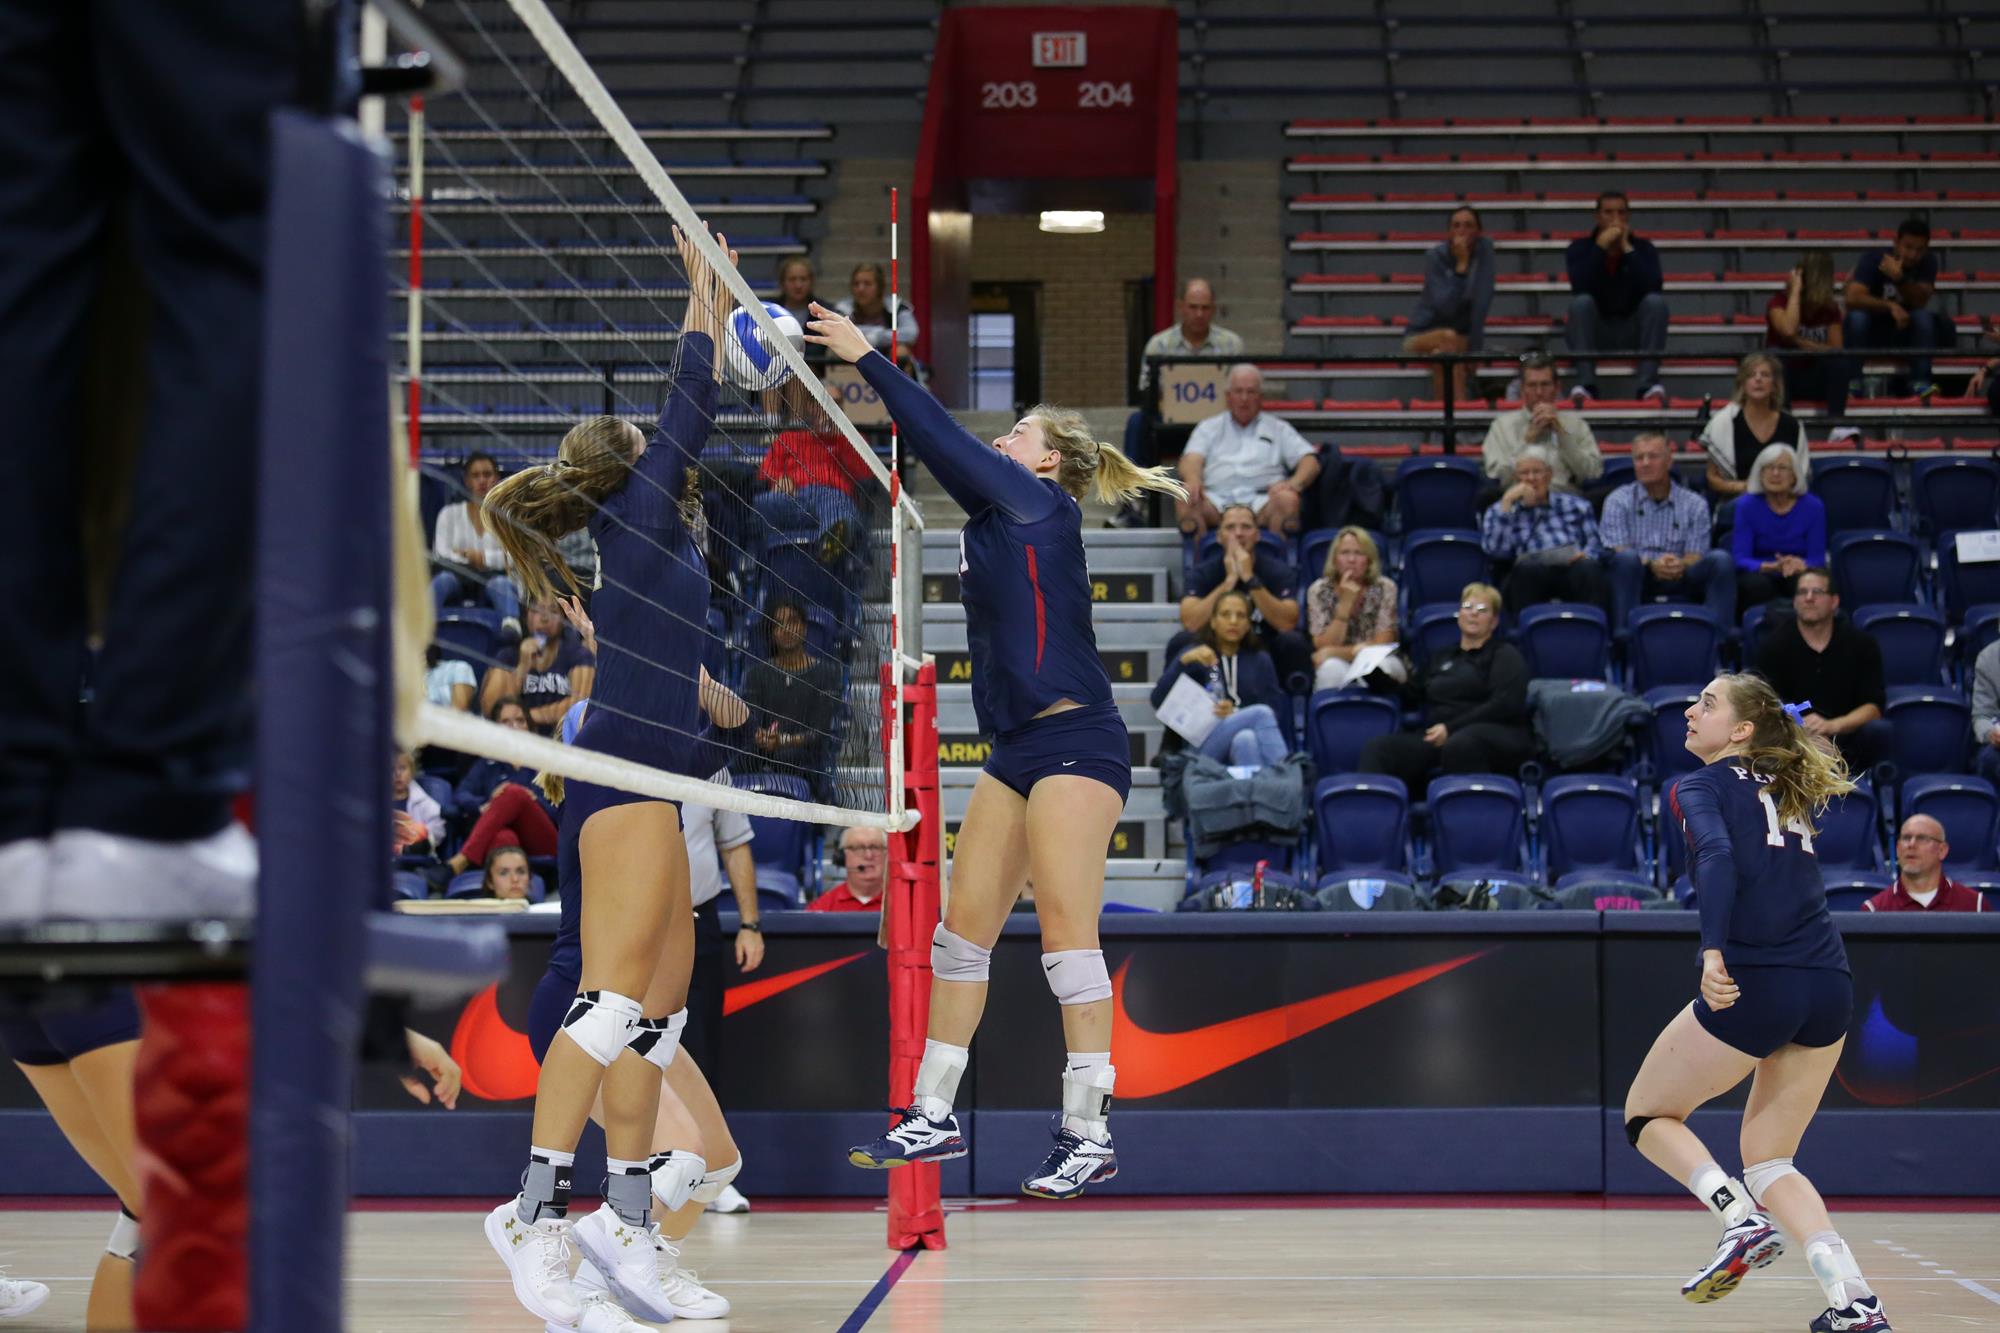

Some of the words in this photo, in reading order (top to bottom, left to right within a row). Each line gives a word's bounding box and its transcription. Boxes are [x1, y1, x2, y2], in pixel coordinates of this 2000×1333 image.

[1040, 37, 1077, 64] EXIT
[982, 82, 1037, 108] 203
[1078, 82, 1134, 108] 204
[843, 382, 880, 404] 03
[1172, 381, 1216, 403] 104
[524, 672, 569, 695] ENN
[1729, 766, 1777, 784] PEN
[1758, 788, 1814, 855] 14
